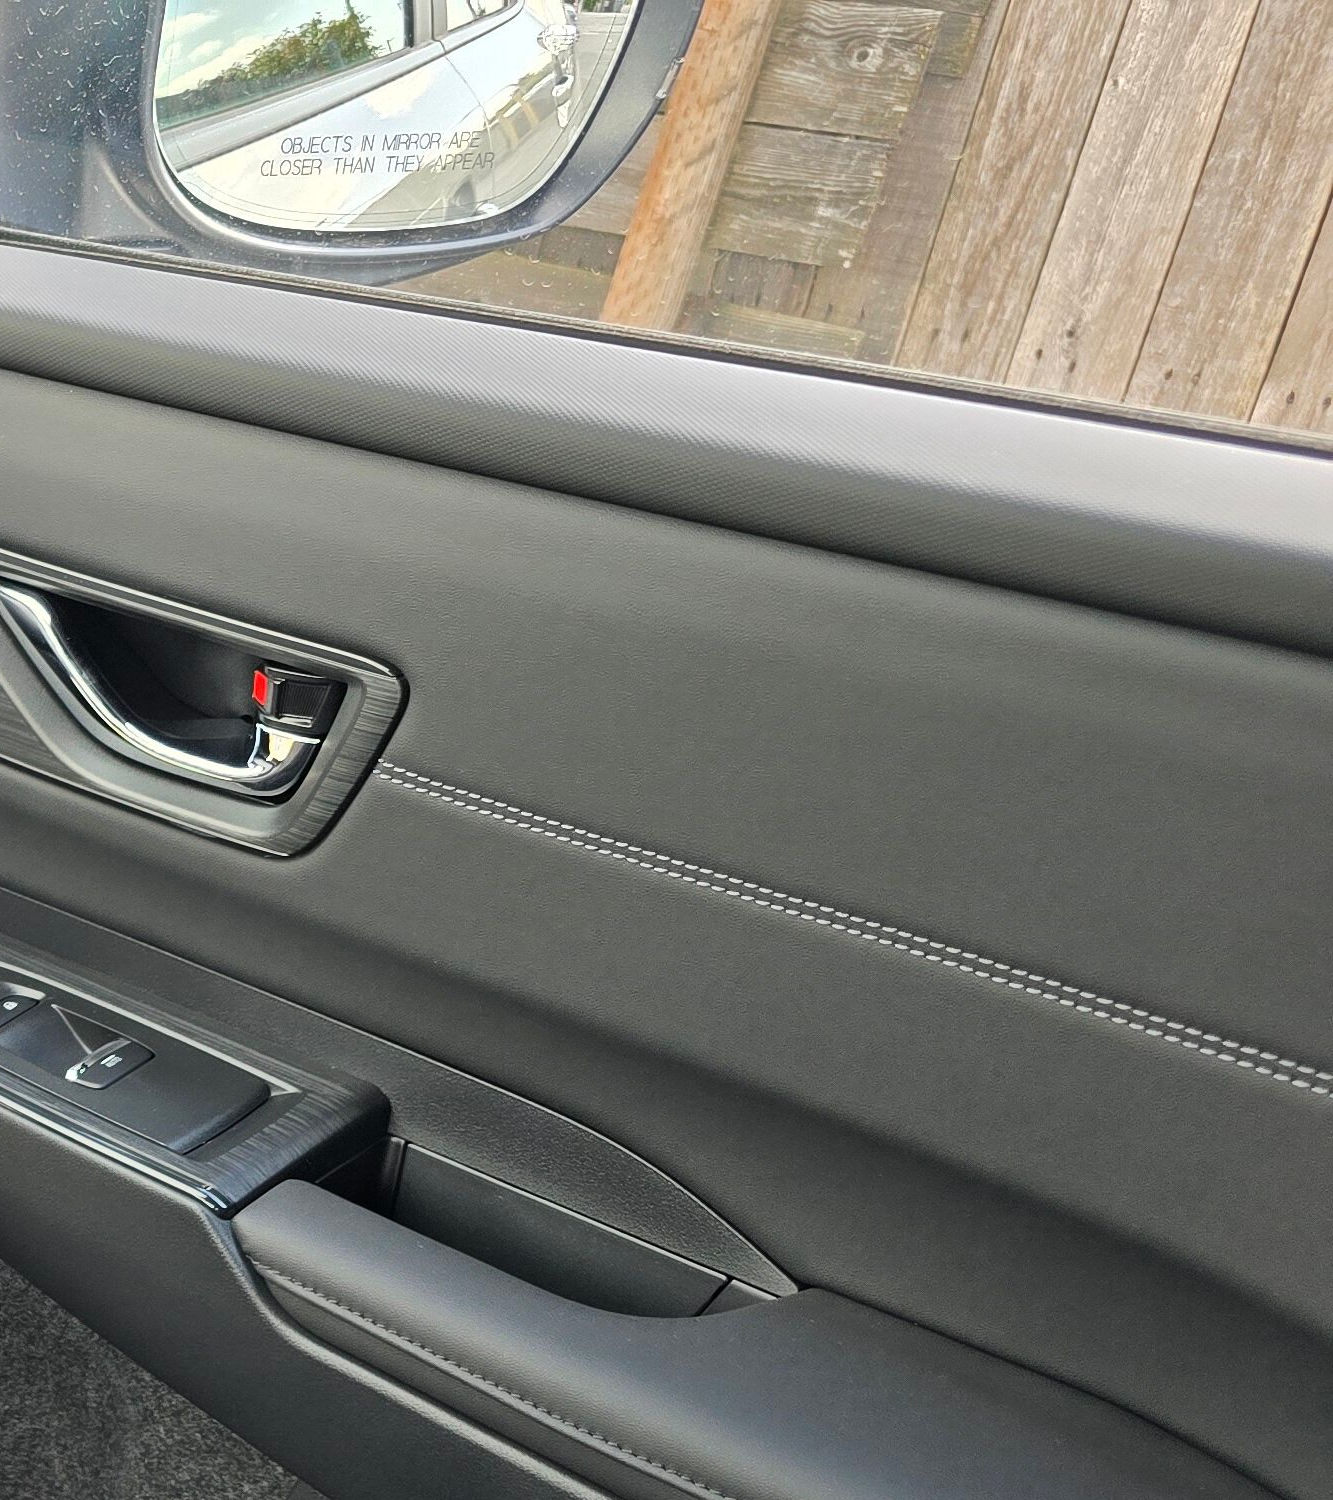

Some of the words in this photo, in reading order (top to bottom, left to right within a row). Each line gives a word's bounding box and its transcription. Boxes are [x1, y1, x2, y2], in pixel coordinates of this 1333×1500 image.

[281, 135, 353, 154] OBJECTS
[360, 135, 375, 152] IN
[382, 133, 442, 151] MIRROR
[448, 131, 481, 149] ARE
[261, 159, 322, 177] CLOSER
[334, 156, 375, 174] THAN
[386, 155, 424, 173] THEY
[430, 152, 494, 173] APPEAR
